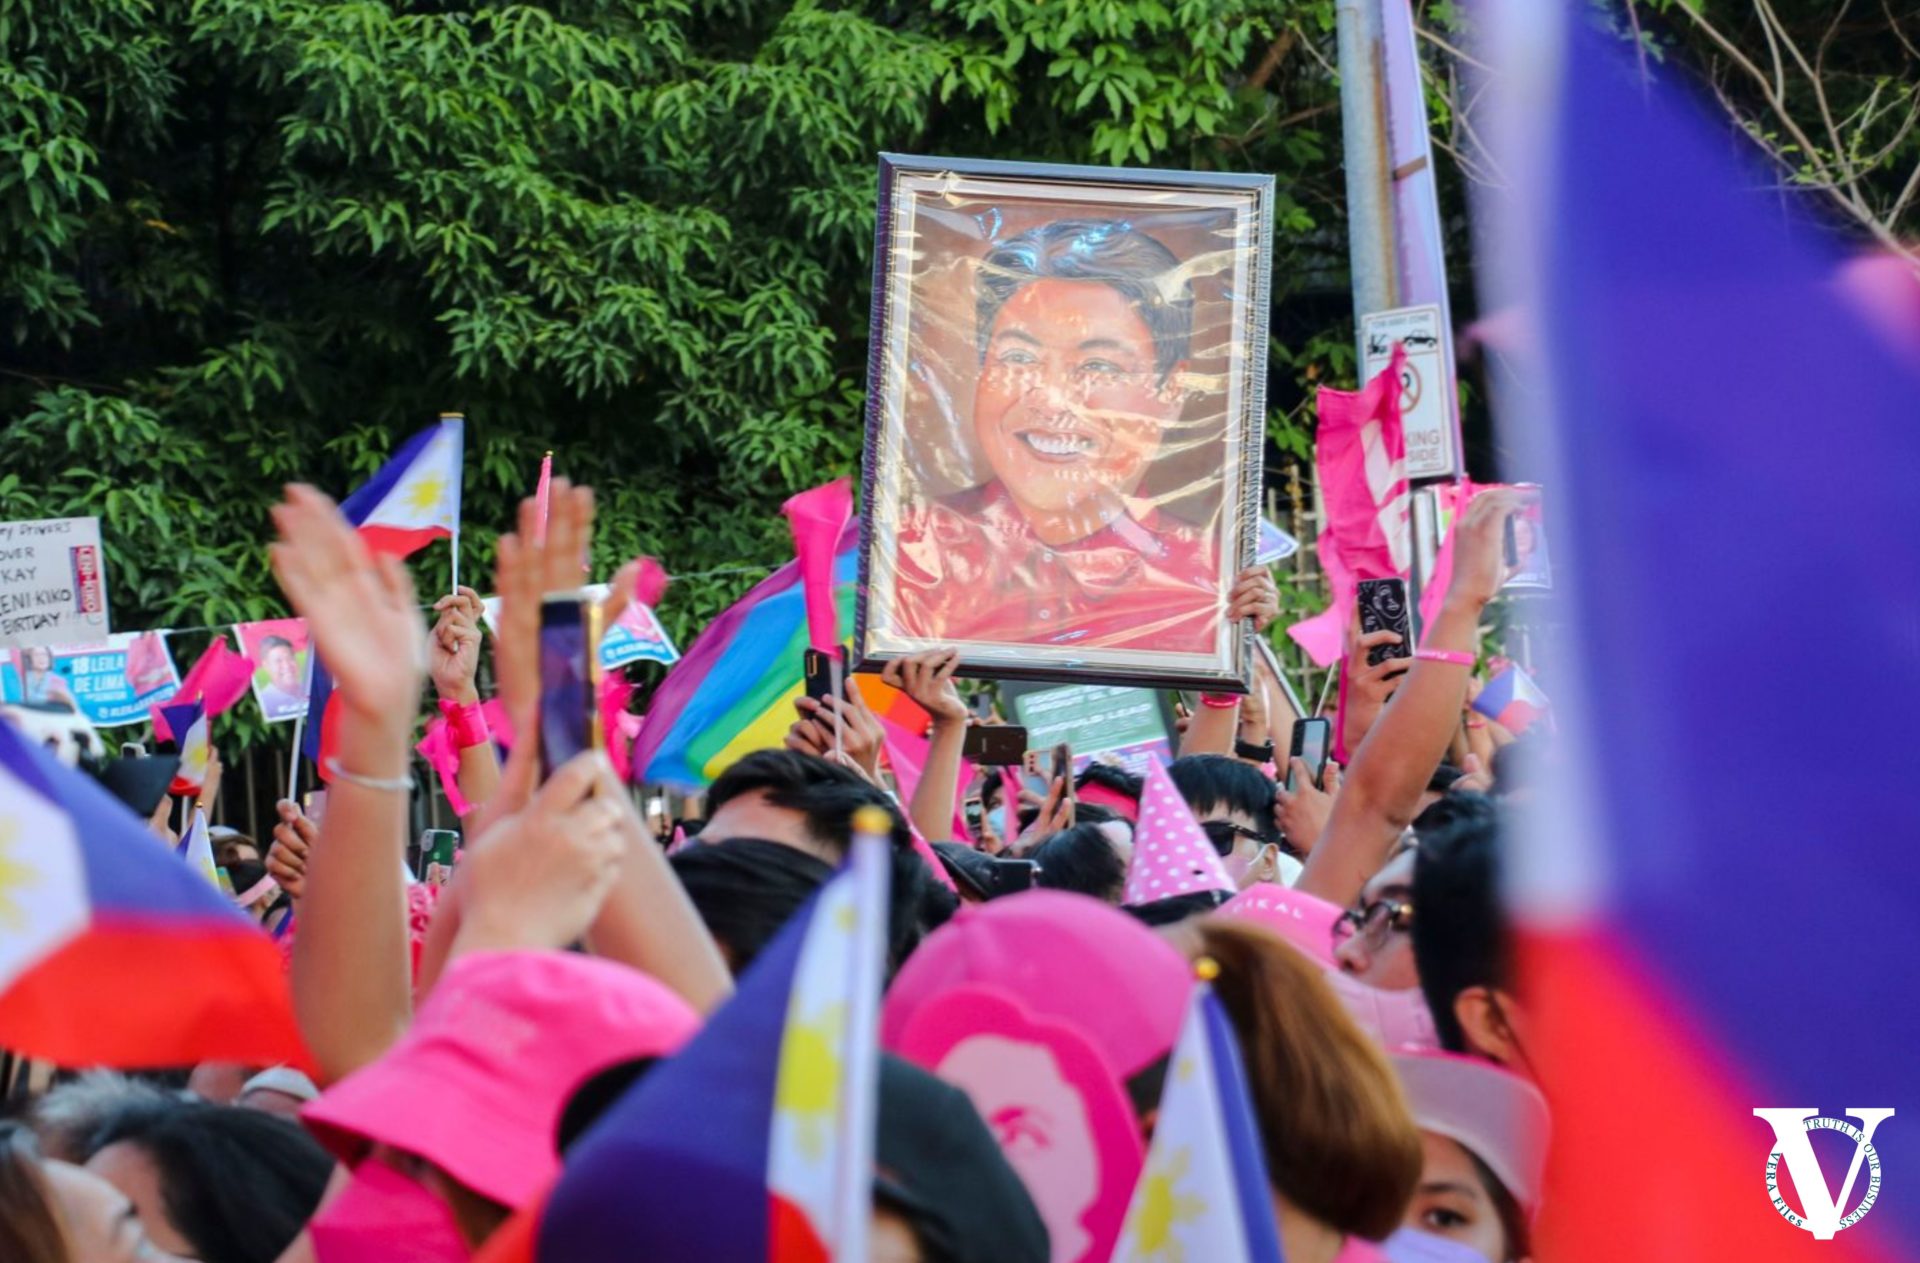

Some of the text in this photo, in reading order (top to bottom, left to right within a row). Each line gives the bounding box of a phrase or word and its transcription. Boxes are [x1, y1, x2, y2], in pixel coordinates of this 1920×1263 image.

[1, 567, 37, 584] KAY
[0, 588, 72, 615] ENI KIKO
[72, 653, 125, 675] 18 LEILA
[74, 673, 126, 693] DE LIMA
